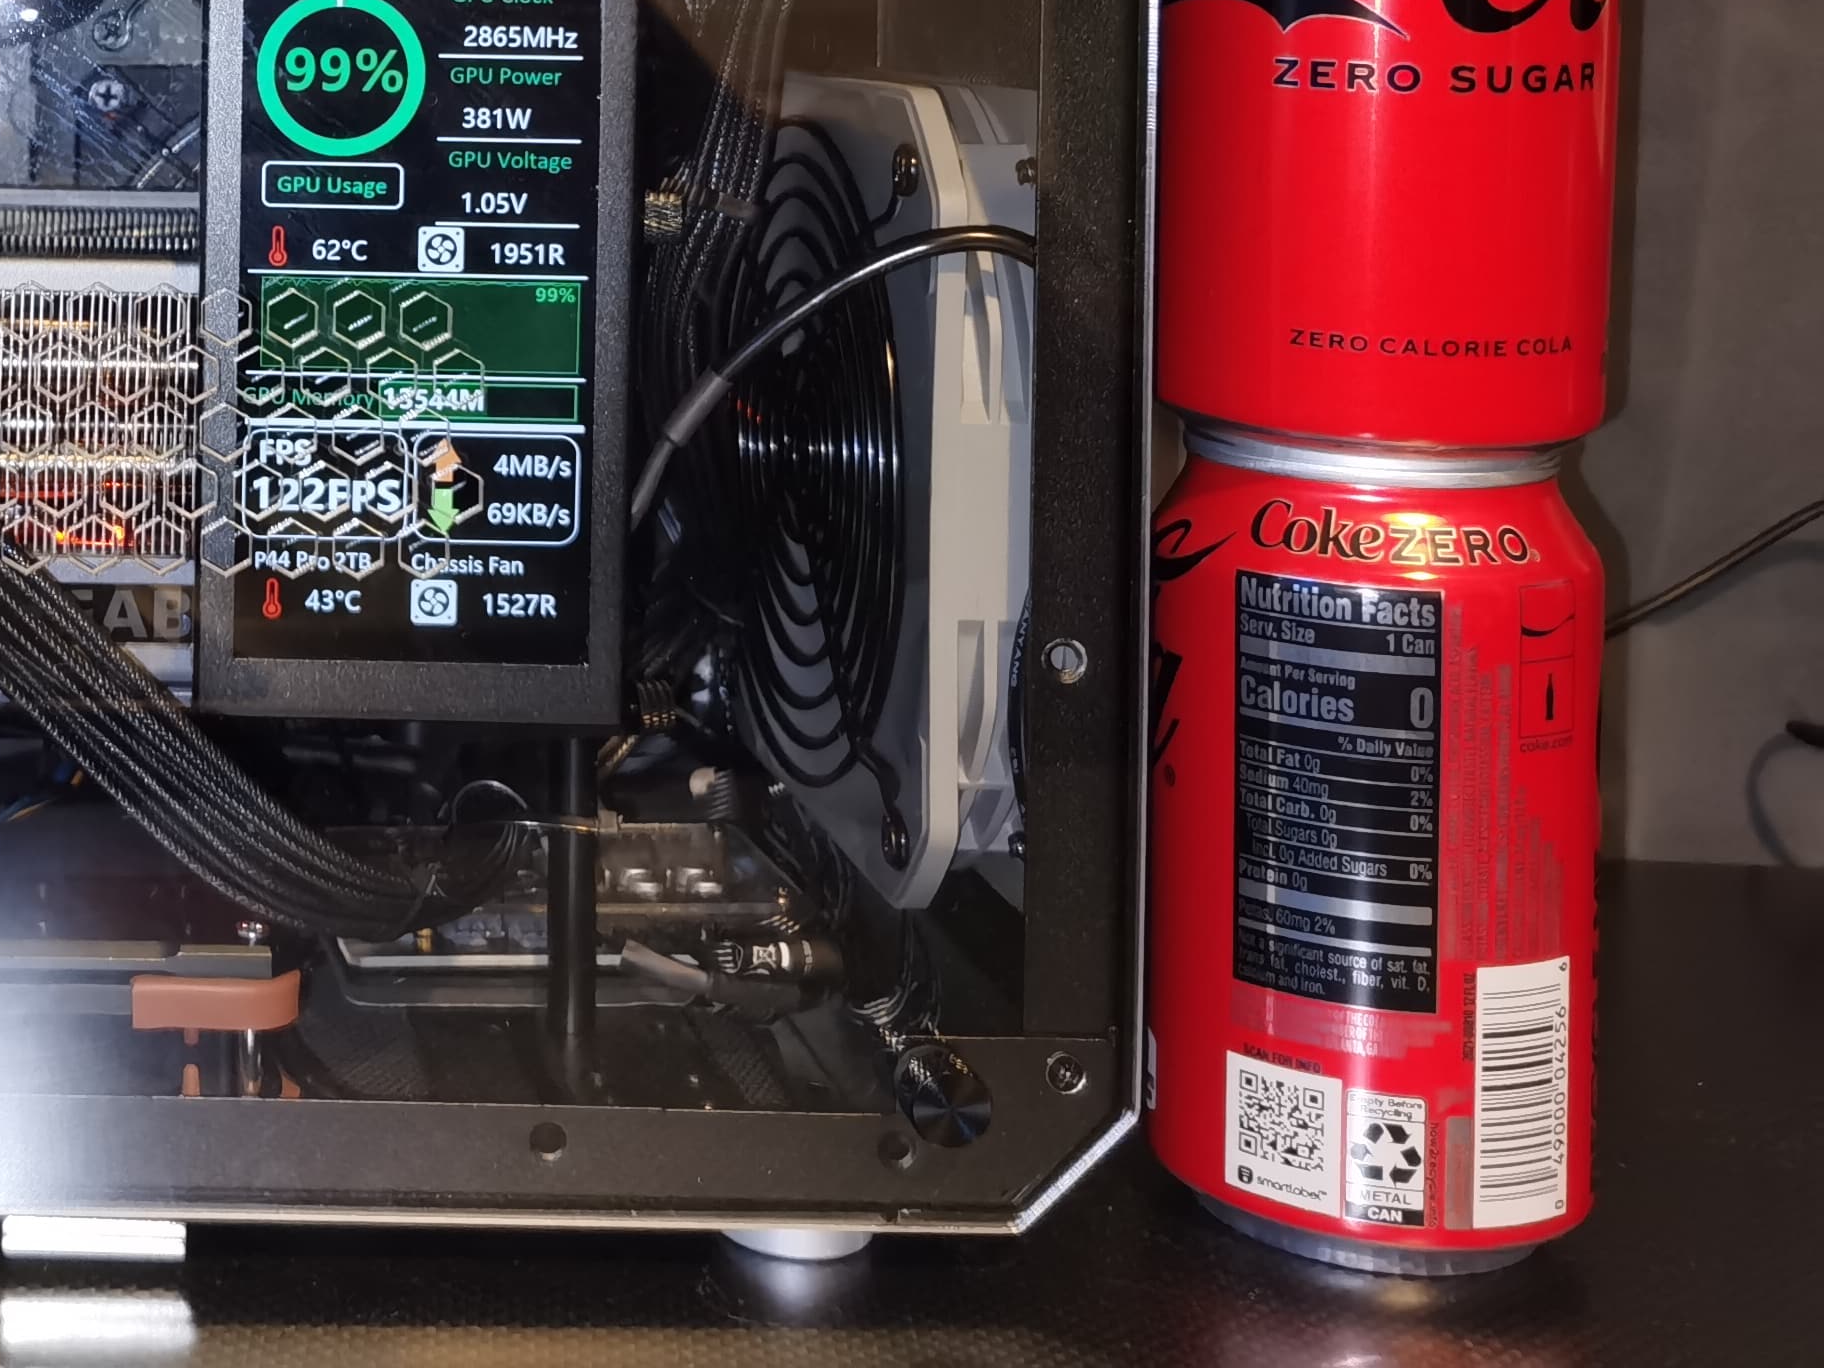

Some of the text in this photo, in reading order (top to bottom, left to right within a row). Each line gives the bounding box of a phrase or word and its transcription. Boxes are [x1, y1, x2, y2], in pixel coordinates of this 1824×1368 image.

[463, 26, 578, 49] 2865MHz
[284, 46, 404, 93] 99%
[450, 67, 563, 87] GPU Power
[1272, 56, 1595, 94] ZERO SUGAR
[462, 107, 532, 130] 381W
[448, 150, 573, 174] GPU Voltage
[277, 175, 388, 199] GPU Usage
[461, 191, 528, 214] 1.05V
[311, 239, 566, 266] 62°C 1951R
[535, 286, 576, 304] 99%
[1289, 328, 1572, 358] ZERO CALORIE COLA
[243, 387, 285, 406] GPU
[292, 388, 374, 411] Memory
[258, 439, 314, 468] FPS
[492, 454, 572, 479] 4MB/s
[252, 477, 404, 514] 122FPS
[487, 502, 571, 528] 69KB/s
[1250, 499, 1382, 561] Coke
[254, 550, 372, 571] P44 Pro 2TB
[410, 552, 524, 575] Chassis Fan
[304, 589, 557, 617] 43°C 1527R
[1240, 575, 1436, 627] Nutrition Facts
[1240, 613, 1435, 655] Serv. Size 1 Can
[1284, 663, 1305, 681] Per
[1308, 668, 1356, 691] Serving
[1240, 674, 1434, 729] Calories 0
[1337, 735, 1434, 759] % Daily Value
[1239, 740, 1434, 783] Total Fat 0g 0%
[1239, 764, 1434, 807] Sodium 40mg 2%
[1239, 788, 1433, 831] Total Carb. 0g 0%
[1246, 812, 1338, 849] Total Sugars 0g
[1239, 857, 1308, 892] Protein 0g
[1278, 845, 1433, 880] 0g Added Sugars 0%
[1276, 907, 1336, 935] 60mg 2%
[1268, 939, 1324, 963] significant
[1327, 952, 1367, 969] source
[1371, 956, 1383, 970] of
[1277, 972, 1326, 995] and iron.
[1352, 970, 1384, 990] fiber,
[1553, 1005, 1568, 1081] 04256
[1350, 1093, 1423, 1110] Empty Before
[1360, 1104, 1413, 1122] Recycling
[1553, 1091, 1567, 1164] 49000
[1360, 1189, 1412, 1206] METAL
[1554, 1199, 1564, 1210] 0
[1367, 1206, 1402, 1223] CAN
